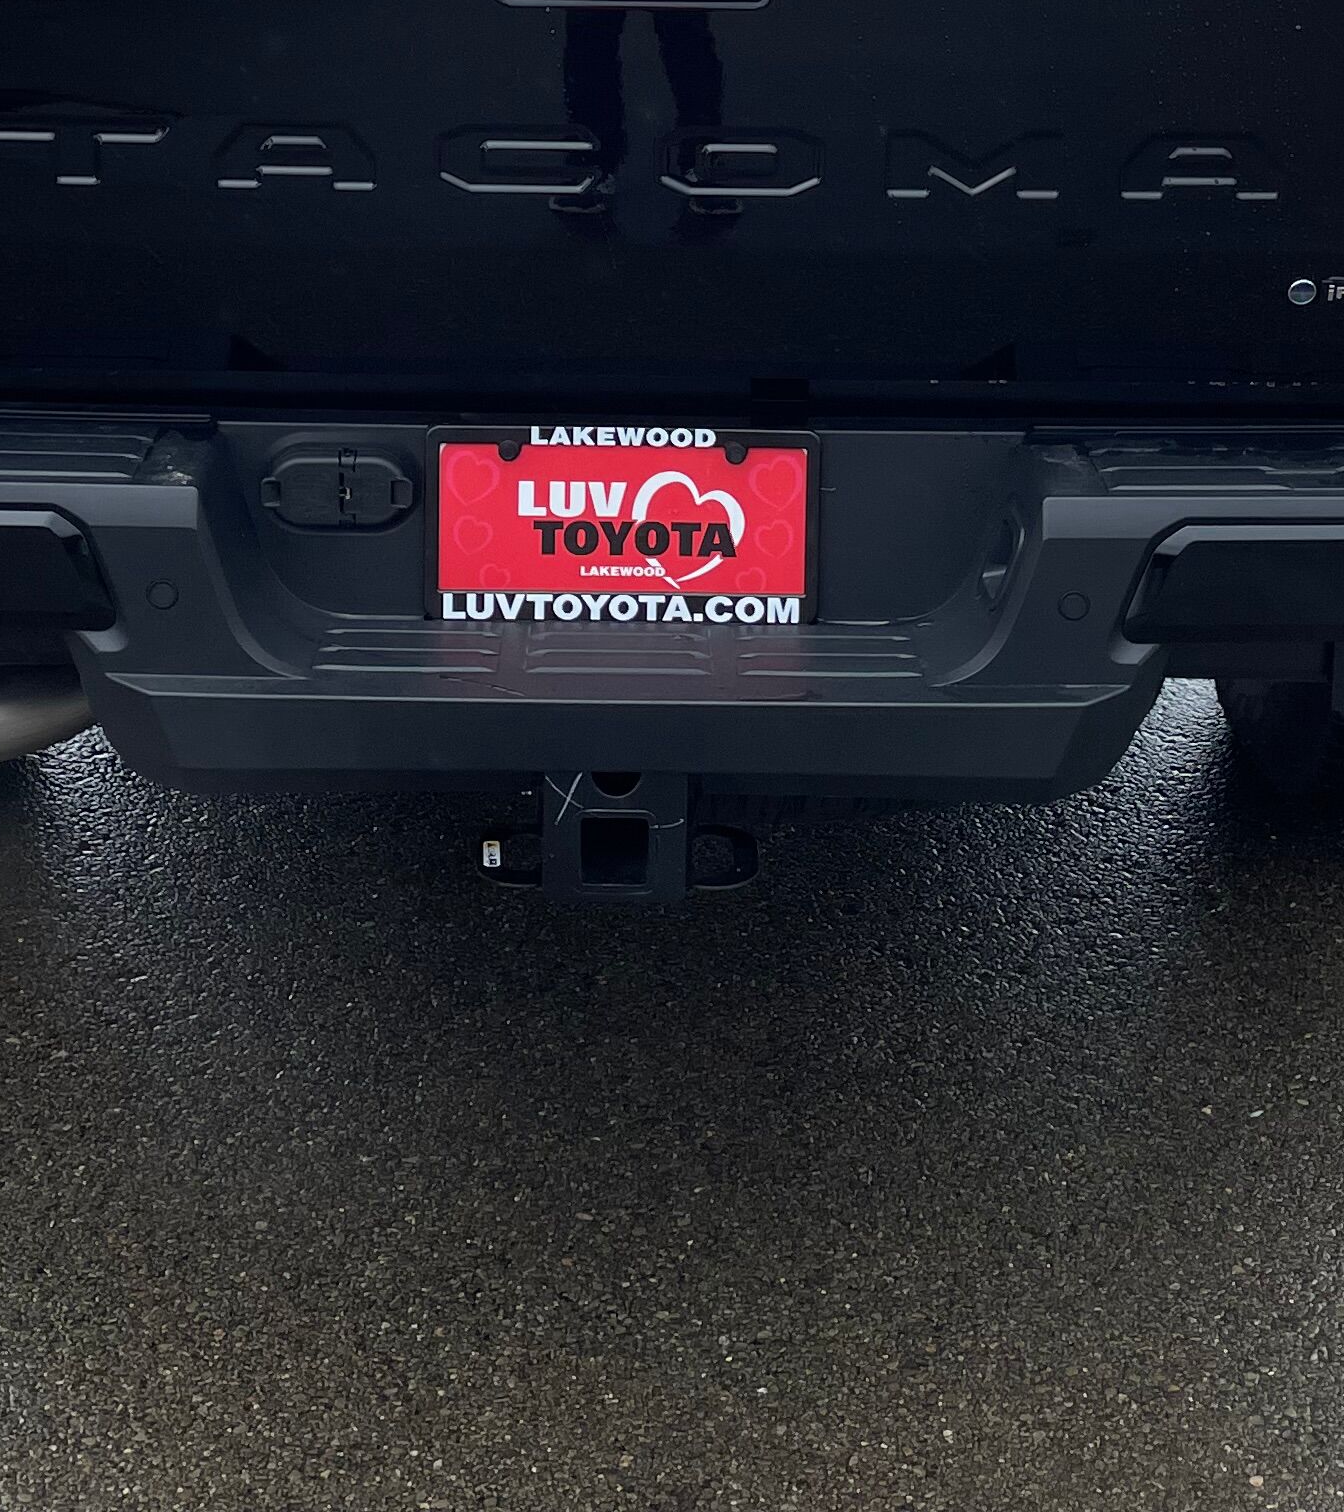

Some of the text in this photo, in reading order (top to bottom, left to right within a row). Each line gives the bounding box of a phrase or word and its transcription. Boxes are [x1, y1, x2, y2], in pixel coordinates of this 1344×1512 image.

[530, 426, 717, 448] LAKEWOOD
[517, 481, 627, 517] LUV
[533, 520, 737, 558] TOYOTA
[579, 565, 666, 578] LAKEWOOD
[442, 592, 800, 624] LUVTOYOTA.COM
